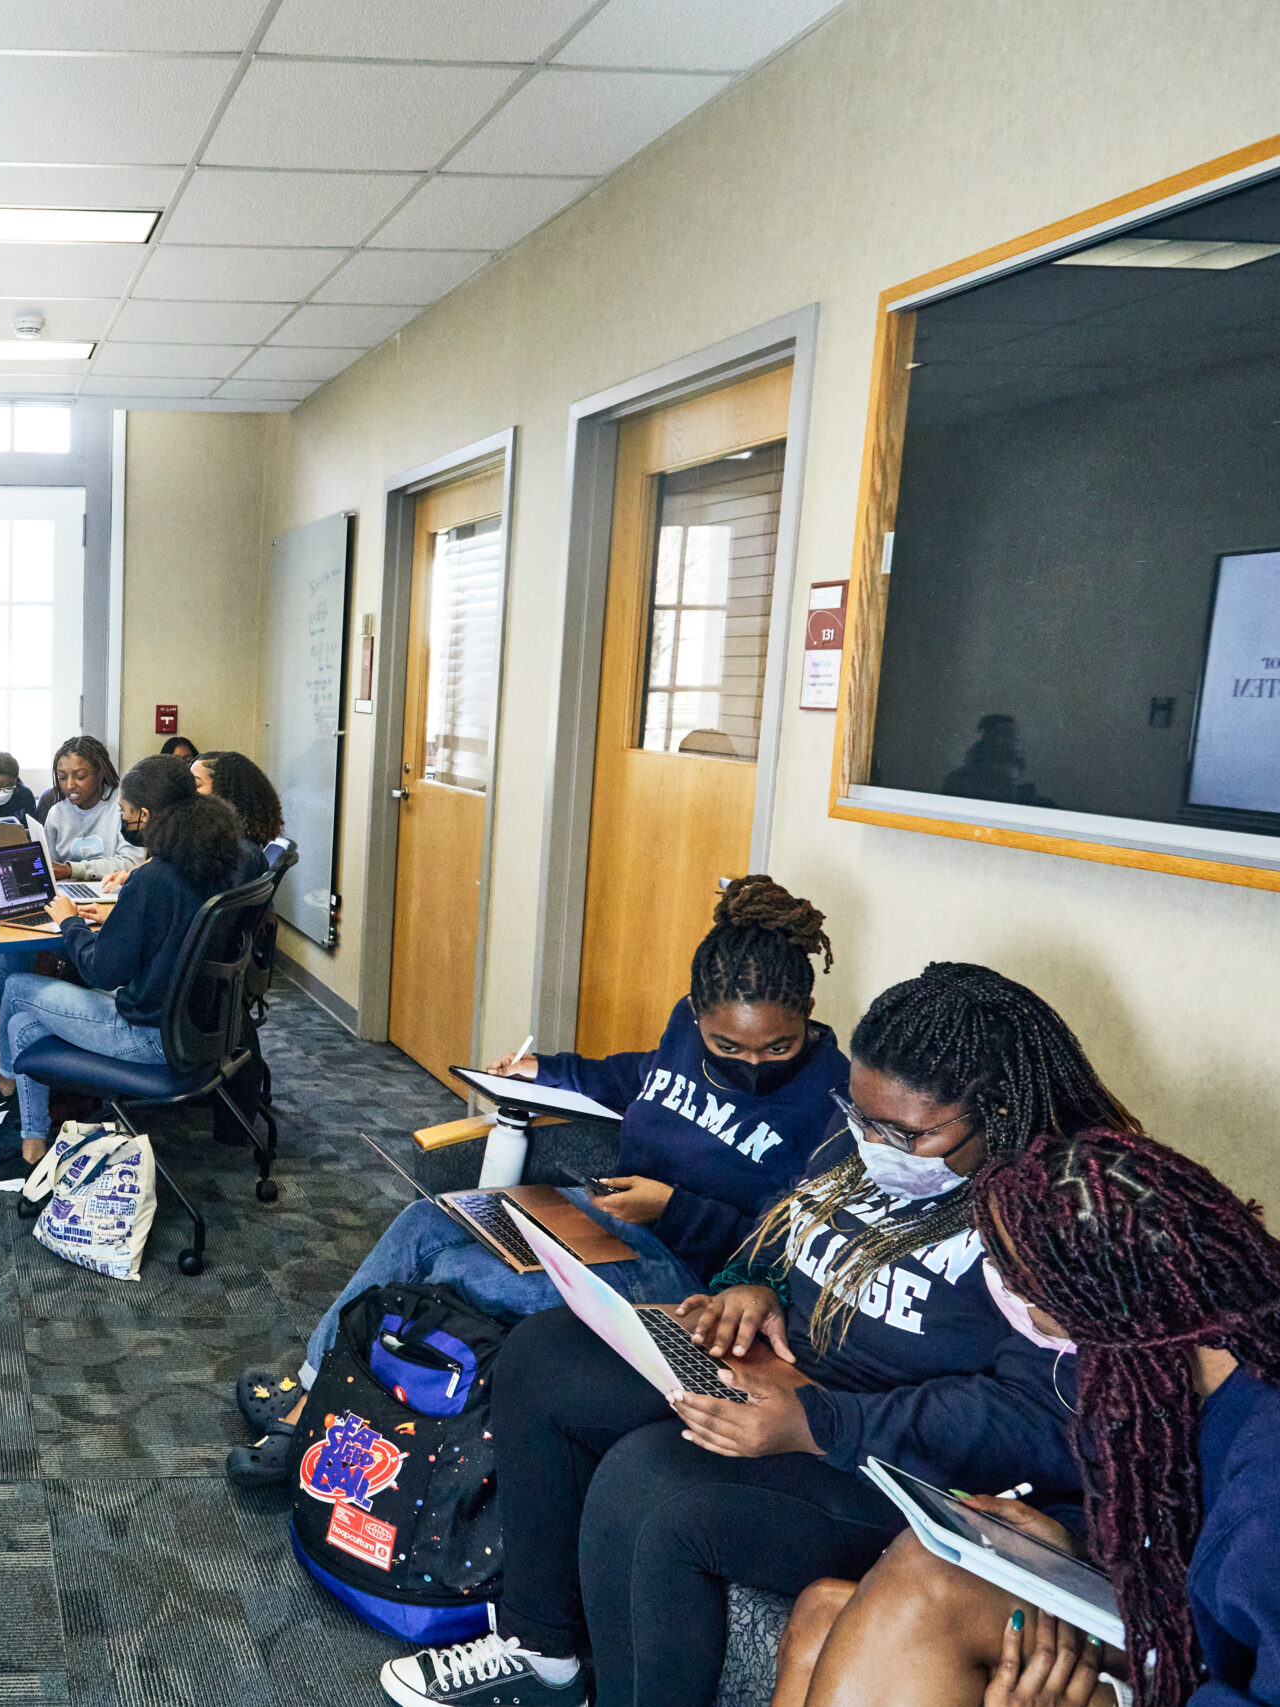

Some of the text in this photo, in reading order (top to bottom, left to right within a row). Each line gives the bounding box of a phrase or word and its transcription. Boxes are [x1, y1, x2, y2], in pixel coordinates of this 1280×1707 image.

[822, 628, 835, 641] 131
[341, 1412, 382, 1452] EAT
[310, 1445, 374, 1512] BALL
[332, 1523, 375, 1552] hoopculture
